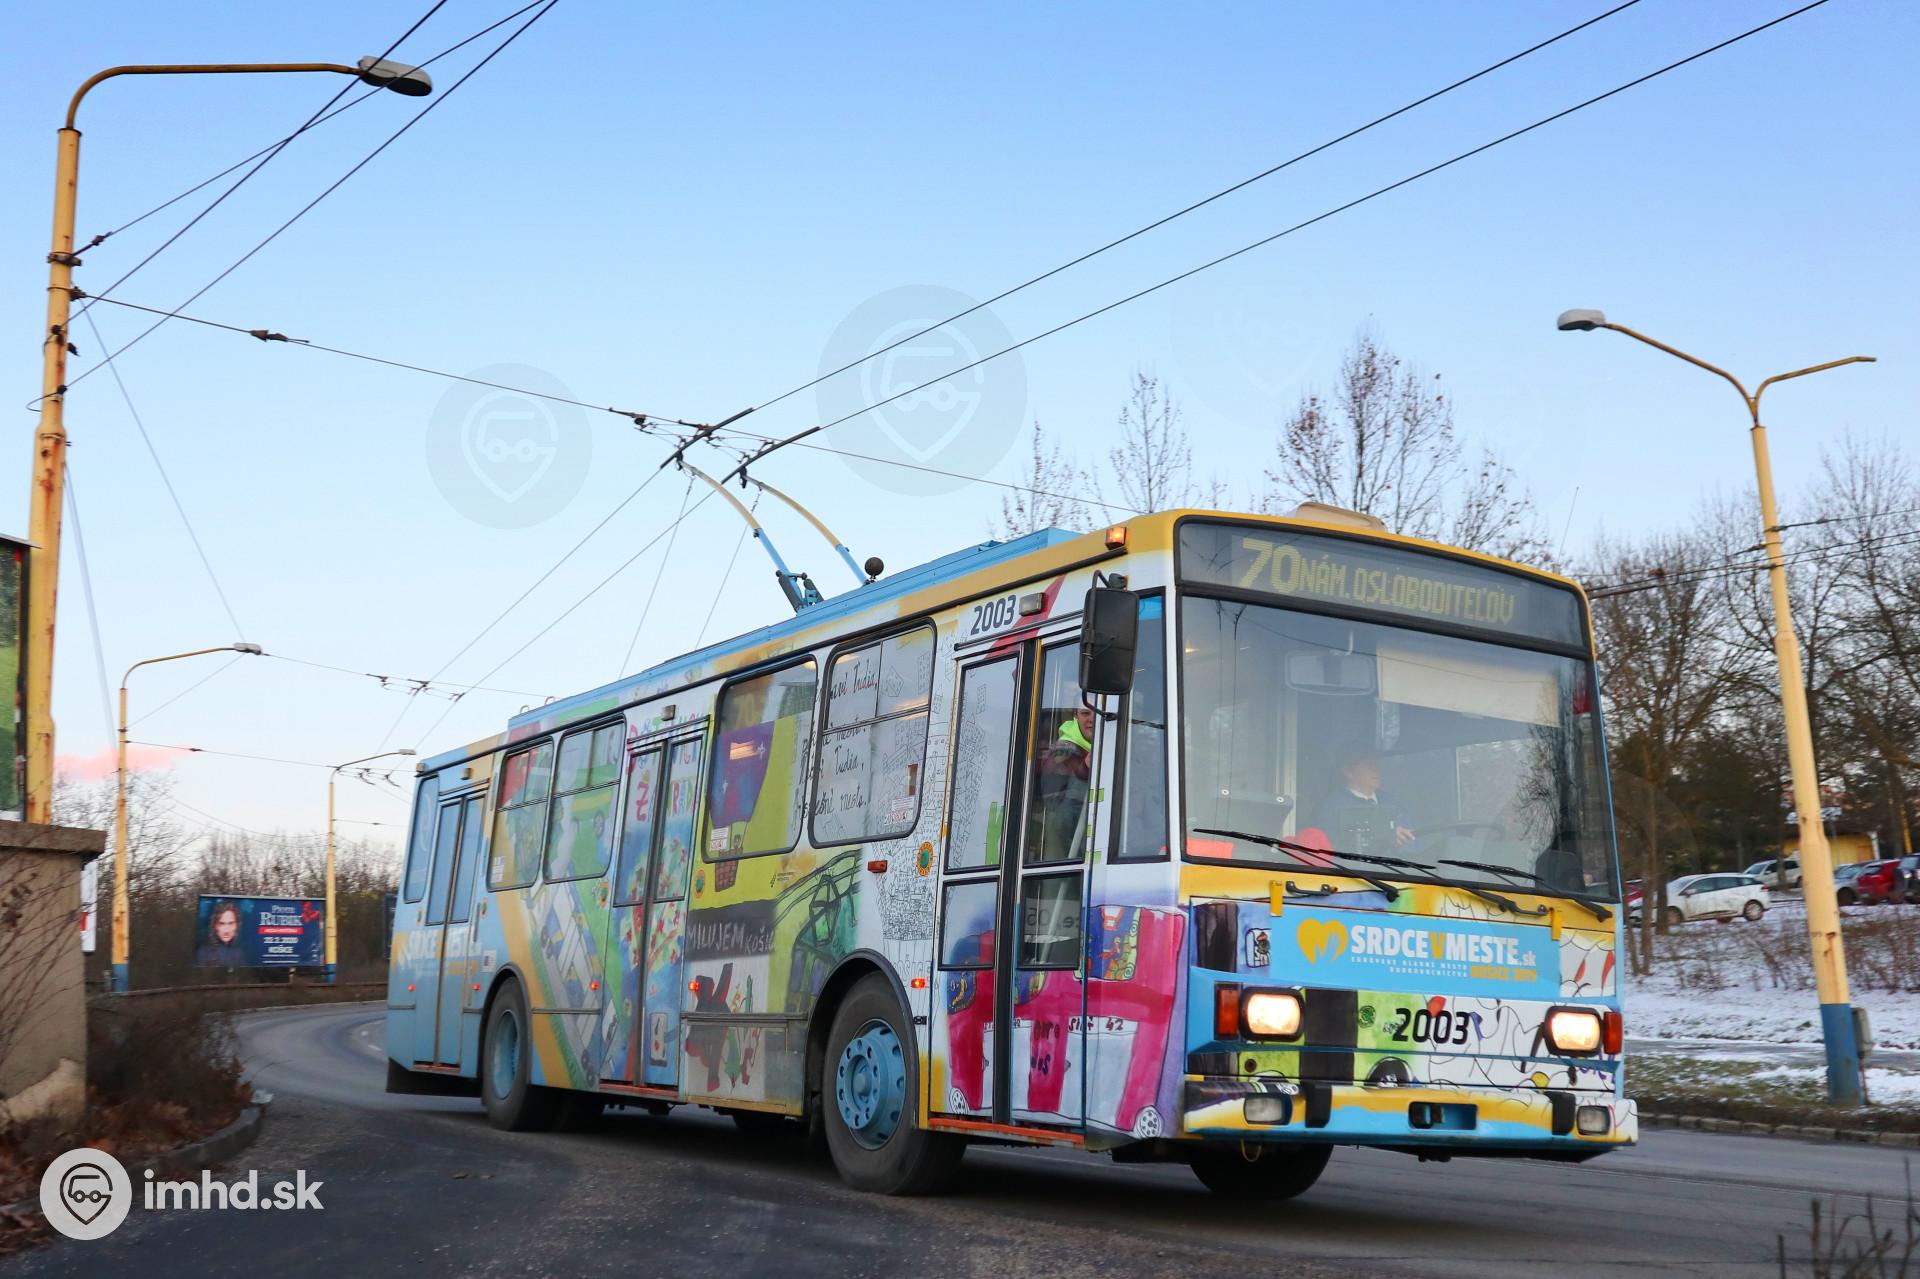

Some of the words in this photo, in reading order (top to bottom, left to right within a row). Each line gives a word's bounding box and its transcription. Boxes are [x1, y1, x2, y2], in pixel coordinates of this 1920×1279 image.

[1239, 537, 1301, 594] 70
[1299, 554, 1351, 599] NÁM.
[970, 594, 1017, 636] 2003
[686, 921, 746, 951] MILUJEM
[1105, 1017, 1124, 1032] 42
[1392, 1007, 1470, 1046] 2003
